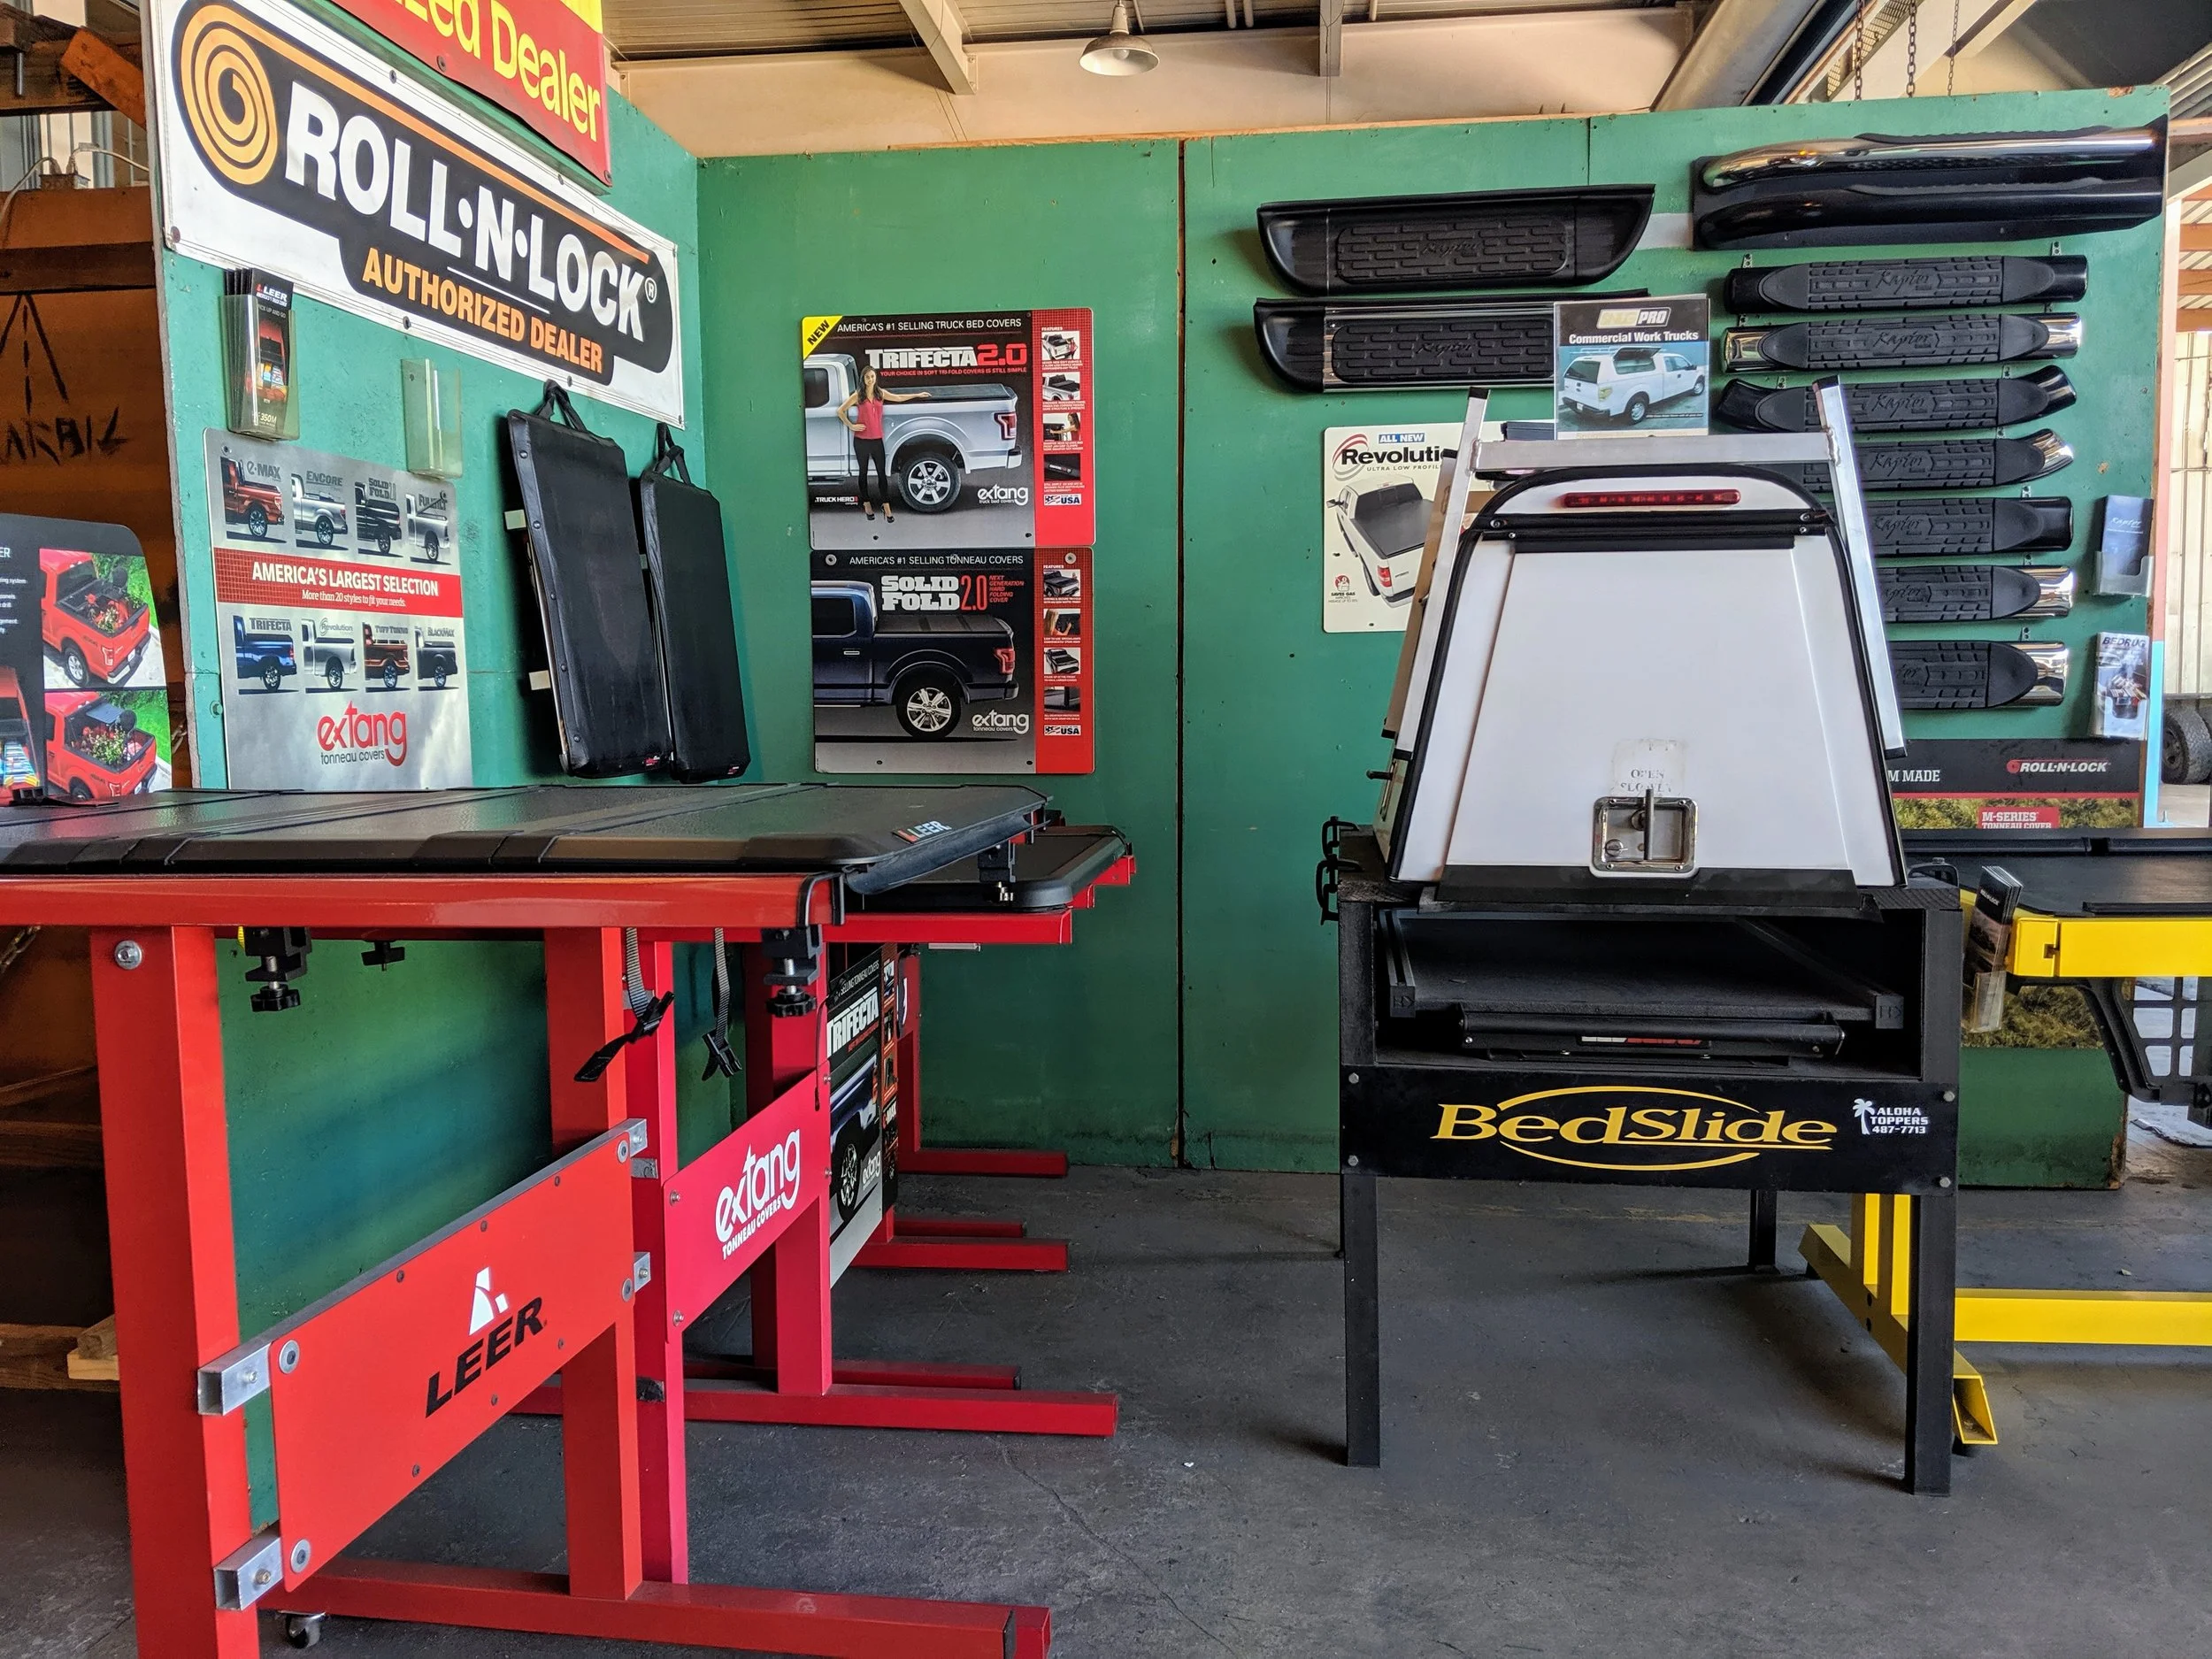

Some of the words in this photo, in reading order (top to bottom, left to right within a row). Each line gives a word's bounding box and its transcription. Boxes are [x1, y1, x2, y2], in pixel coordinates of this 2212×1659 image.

[491, 0, 601, 142] Dealer
[1876, 269, 1930, 296] Raptor
[263, 285, 288, 302] LEER
[363, 248, 525, 342] AUTHORIZED
[531, 314, 603, 374] DEALER
[1637, 310, 1667, 326] PRO
[807, 319, 830, 345] NEW
[837, 323, 884, 333] AMERICA'S
[886, 322, 895, 331] #1
[898, 320, 933, 331] SELLING
[935, 319, 964, 329] TRUCK
[966, 319, 984, 328] BED
[987, 318, 1021, 327] COVERS
[1569, 333, 1632, 345] Commercial
[1633, 332, 1660, 343] Work
[1663, 330, 1699, 342] Trucks
[1873, 331, 1932, 353] Raptor
[864, 346, 978, 369] TRIFECTA
[977, 343, 1027, 367] 2.0
[1871, 393, 1925, 419] Raptor
[1379, 434, 1397, 443] ALL
[1399, 433, 1425, 442] NEW
[1341, 445, 1444, 465] Revoluti
[1870, 451, 1924, 477] Raptor
[368, 477, 389, 489] SOLID
[369, 488, 389, 500] FOLD
[977, 484, 1029, 506] extang
[909, 556, 944, 565] SELLING
[945, 556, 987, 565] TONNEAU
[988, 555, 1024, 564] COVERS
[252, 561, 326, 588] AMERICA'S
[329, 569, 381, 592] LARGEST
[383, 578, 439, 597] SELECTION
[302, 589, 319, 601] More
[319, 590, 335, 602] than
[335, 591, 343, 603] 20
[343, 593, 362, 605] styles
[362, 595, 369, 604] to
[375, 596, 388, 607] your
[881, 575, 960, 592] SOLID
[960, 574, 988, 611] 2.0
[881, 592, 960, 611] FOLD
[250, 617, 292, 631] TRIFECTA
[320, 621, 353, 632] Revolution
[2102, 636, 2147, 648] BEDRUG
[972, 709, 1030, 734] extang
[317, 700, 407, 767] extang
[320, 751, 357, 765] tonneau
[358, 749, 385, 762] covers
[1902, 769, 1941, 783] MADE
[1981, 811, 2037, 822] M-SERIES
[907, 820, 949, 838] LEER
[826, 987, 879, 1059] TRIFECTA
[1870, 1116, 1929, 1125] TOPPERS
[1876, 1107, 1922, 1116] ALOHA
[1431, 1103, 1838, 1147] BedSlide
[716, 1128, 801, 1242] extang
[722, 1217, 757, 1260] TONNEAU
[756, 1195, 781, 1228] COVERS
[426, 1296, 544, 1418] LEER
